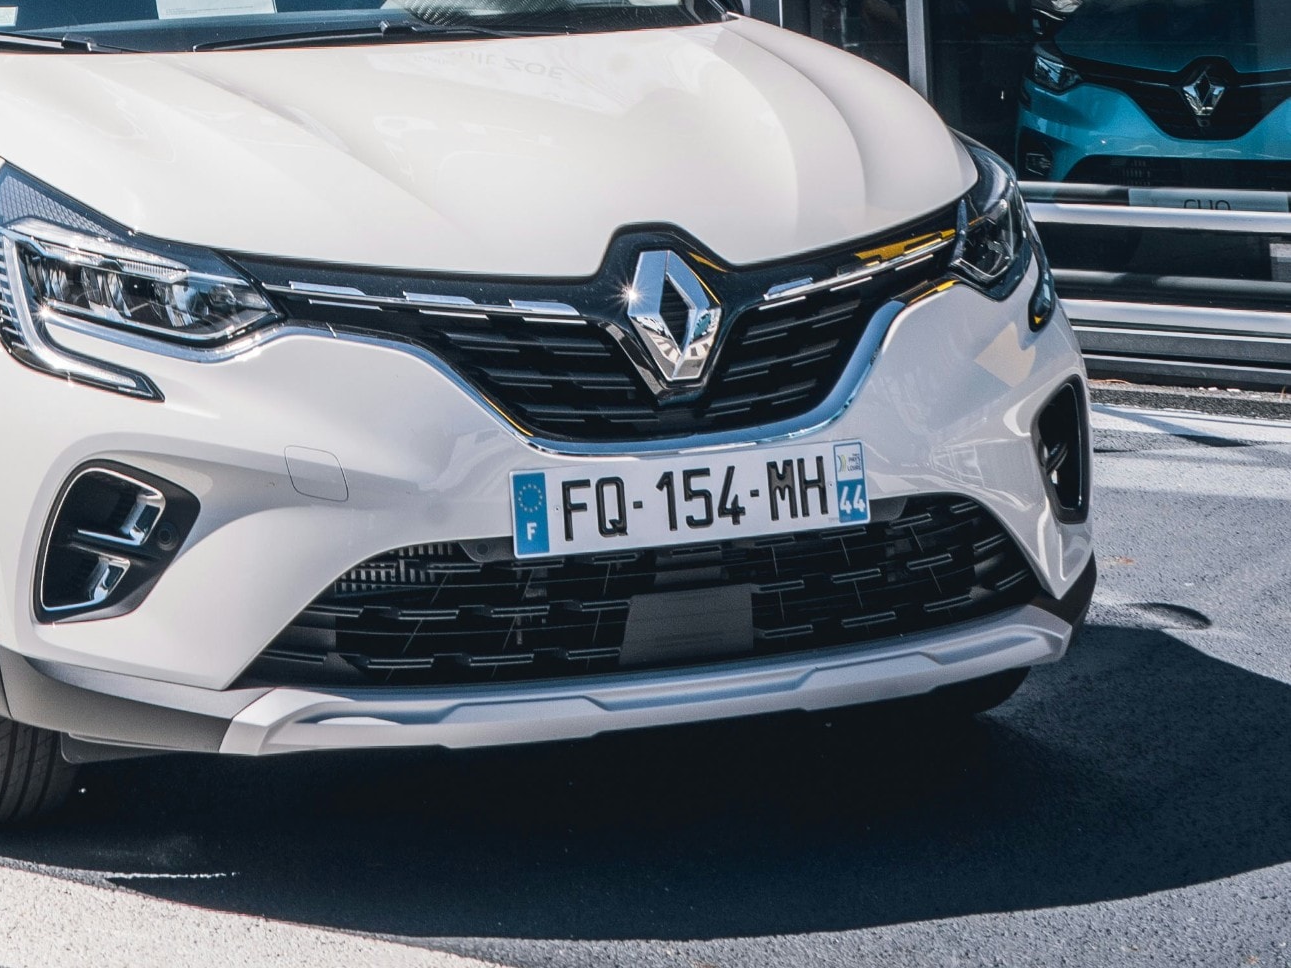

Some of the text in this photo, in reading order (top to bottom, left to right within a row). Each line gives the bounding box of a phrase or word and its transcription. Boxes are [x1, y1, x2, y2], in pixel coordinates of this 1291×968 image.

[526, 456, 866, 542] F FQ-154-MH 44
